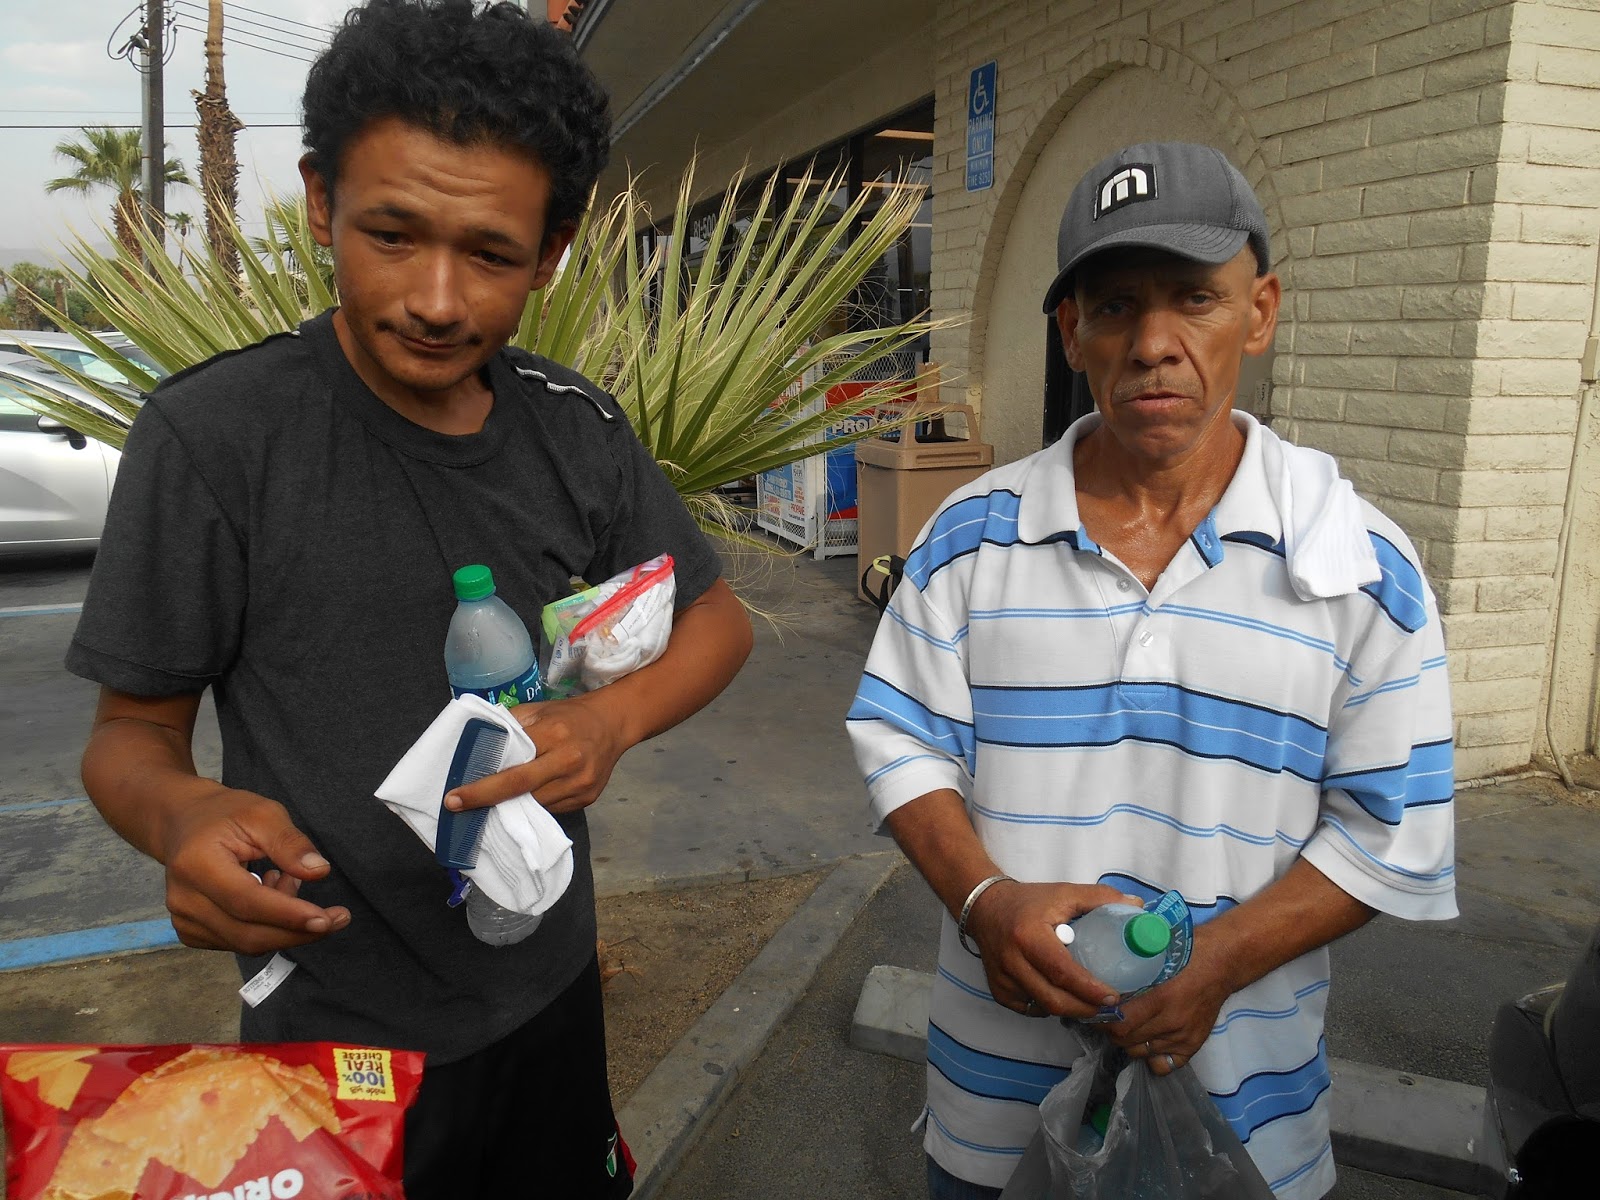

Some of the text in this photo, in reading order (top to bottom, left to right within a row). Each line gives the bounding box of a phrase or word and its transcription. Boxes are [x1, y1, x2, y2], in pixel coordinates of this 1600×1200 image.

[968, 112, 992, 136] PARKING
[972, 133, 988, 154] ONLY
[970, 157, 989, 171] MINIMUM
[968, 173, 979, 188] FINE
[342, 1051, 383, 1061] CHEESE
[343, 1059, 384, 1074] REAL
[342, 1071, 385, 1088] 100%
